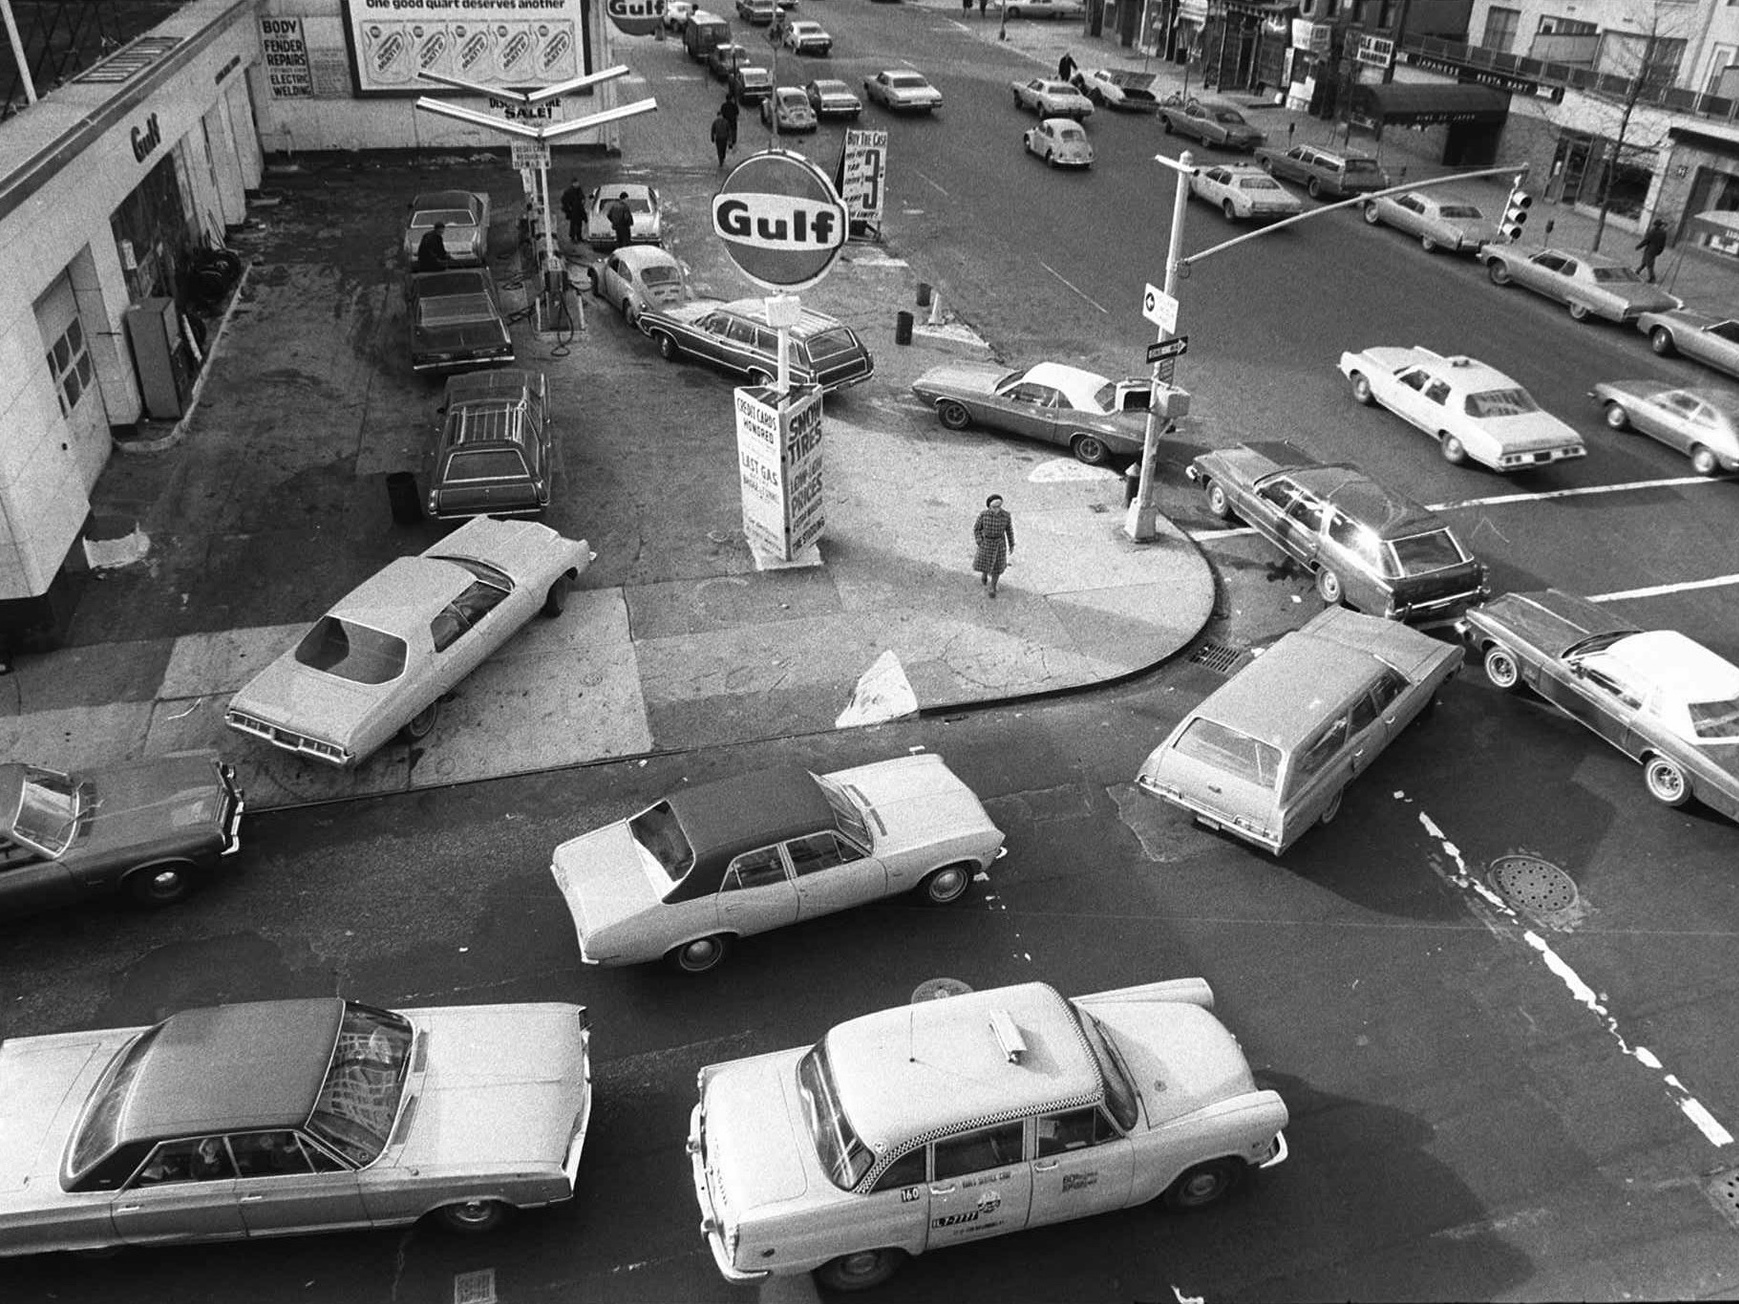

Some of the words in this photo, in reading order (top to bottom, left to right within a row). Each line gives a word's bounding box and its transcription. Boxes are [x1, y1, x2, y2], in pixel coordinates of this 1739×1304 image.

[366, 0, 390, 8] One
[392, 0, 423, 9] good
[426, 0, 459, 9] quart
[462, 0, 516, 8] deserves
[518, 0, 565, 8] another
[609, 0, 664, 15] Gulf
[262, 20, 296, 33] BODY
[264, 40, 303, 52] FENDER
[266, 54, 306, 66] REPAIRS
[270, 74, 308, 85] ELECTRIC
[1416, 60, 1459, 76] JAPANESE
[1477, 74, 1528, 91] RESTARANT
[273, 86, 313, 96] WELDING
[504, 107, 552, 119] SALE!
[131, 113, 161, 163] Gulf
[848, 132, 859, 145] BUY
[861, 132, 871, 146] THE
[873, 132, 886, 147] CASE
[717, 200, 835, 244] Gulf
[737, 397, 756, 420] CREDIT
[757, 409, 776, 431] CARDS
[789, 396, 822, 442] SNOW
[744, 418, 774, 445] HONORED
[787, 420, 822, 466] TIRES
[741, 451, 758, 474] LAST
[761, 464, 778, 486] GAS
[791, 469, 808, 495] LOW
[791, 472, 823, 518] PRICES
[901, 1188, 919, 1200] 160
